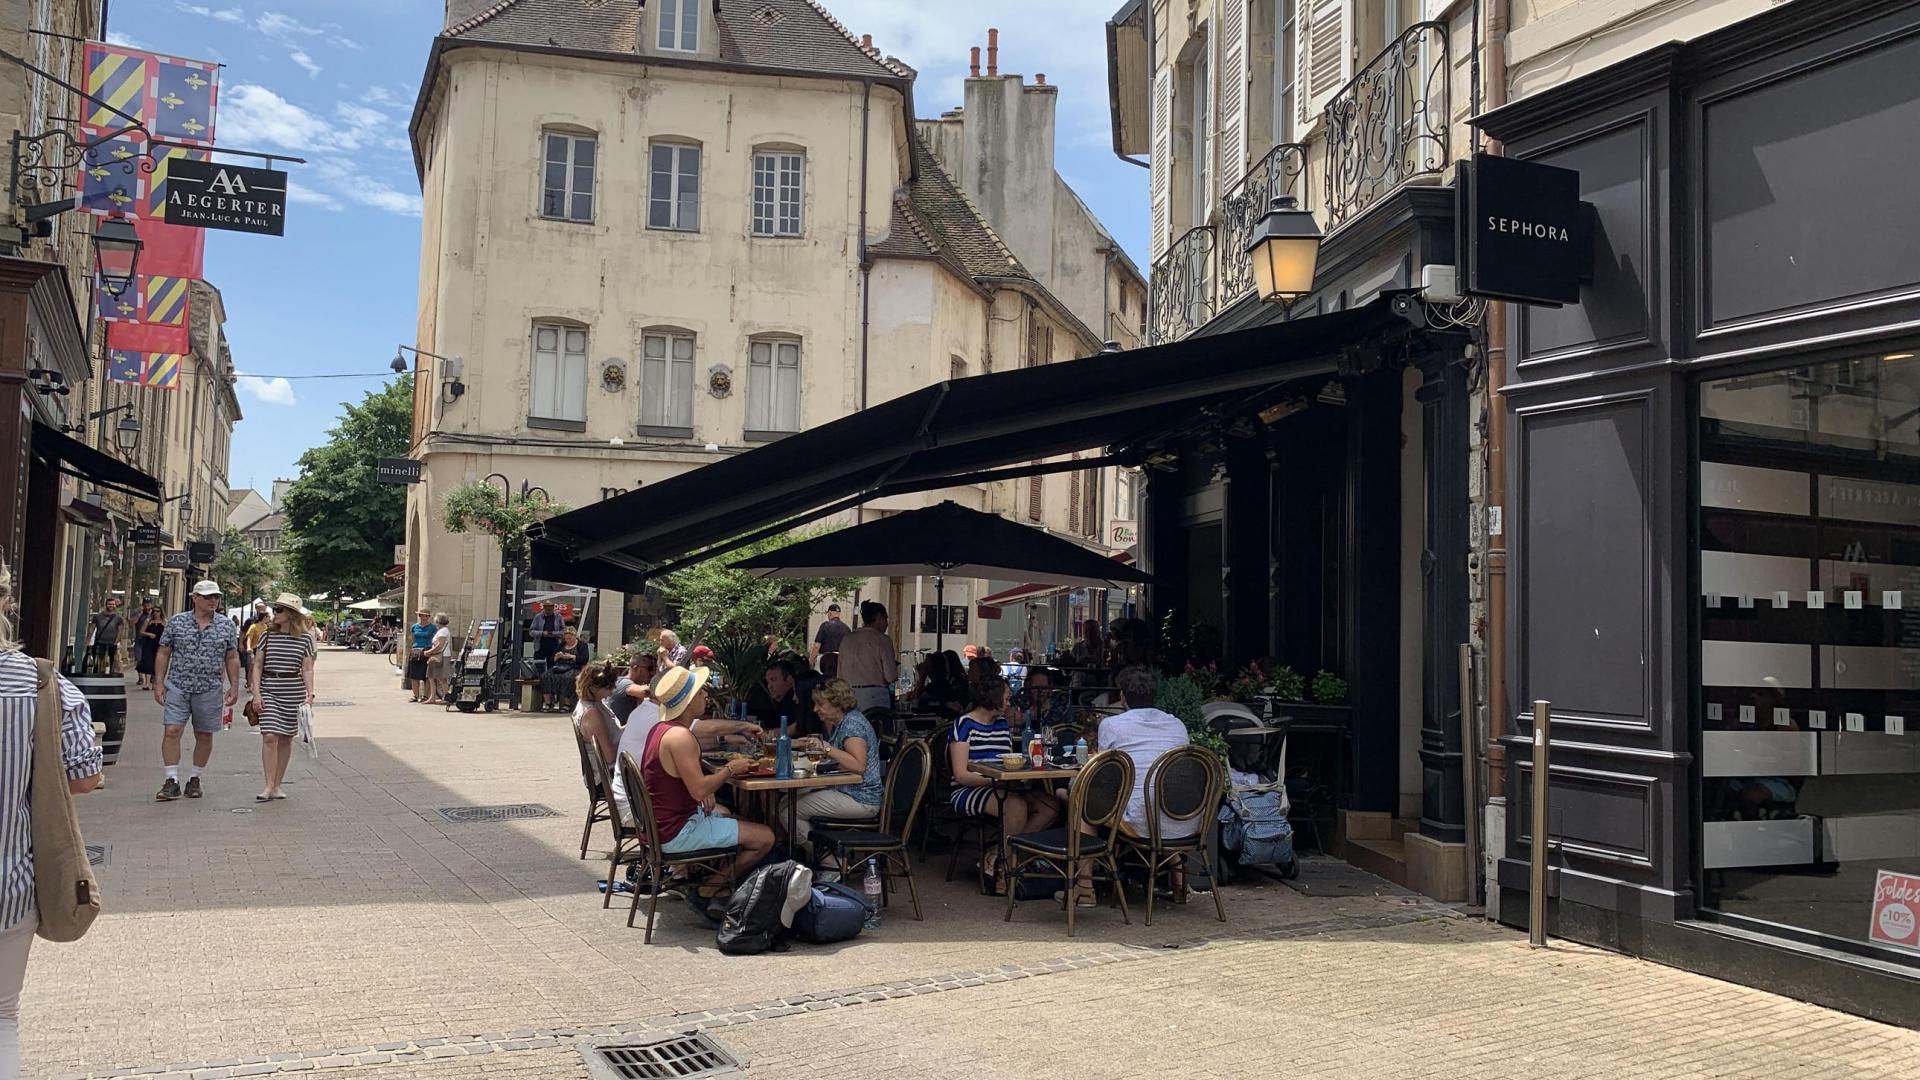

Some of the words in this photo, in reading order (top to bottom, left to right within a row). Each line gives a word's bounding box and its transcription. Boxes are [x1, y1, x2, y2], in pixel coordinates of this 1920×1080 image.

[169, 190, 282, 217] AEGERTER
[1488, 216, 1569, 242] SEPHORA
[380, 465, 419, 477] minelli
[540, 602, 568, 610] SDES
